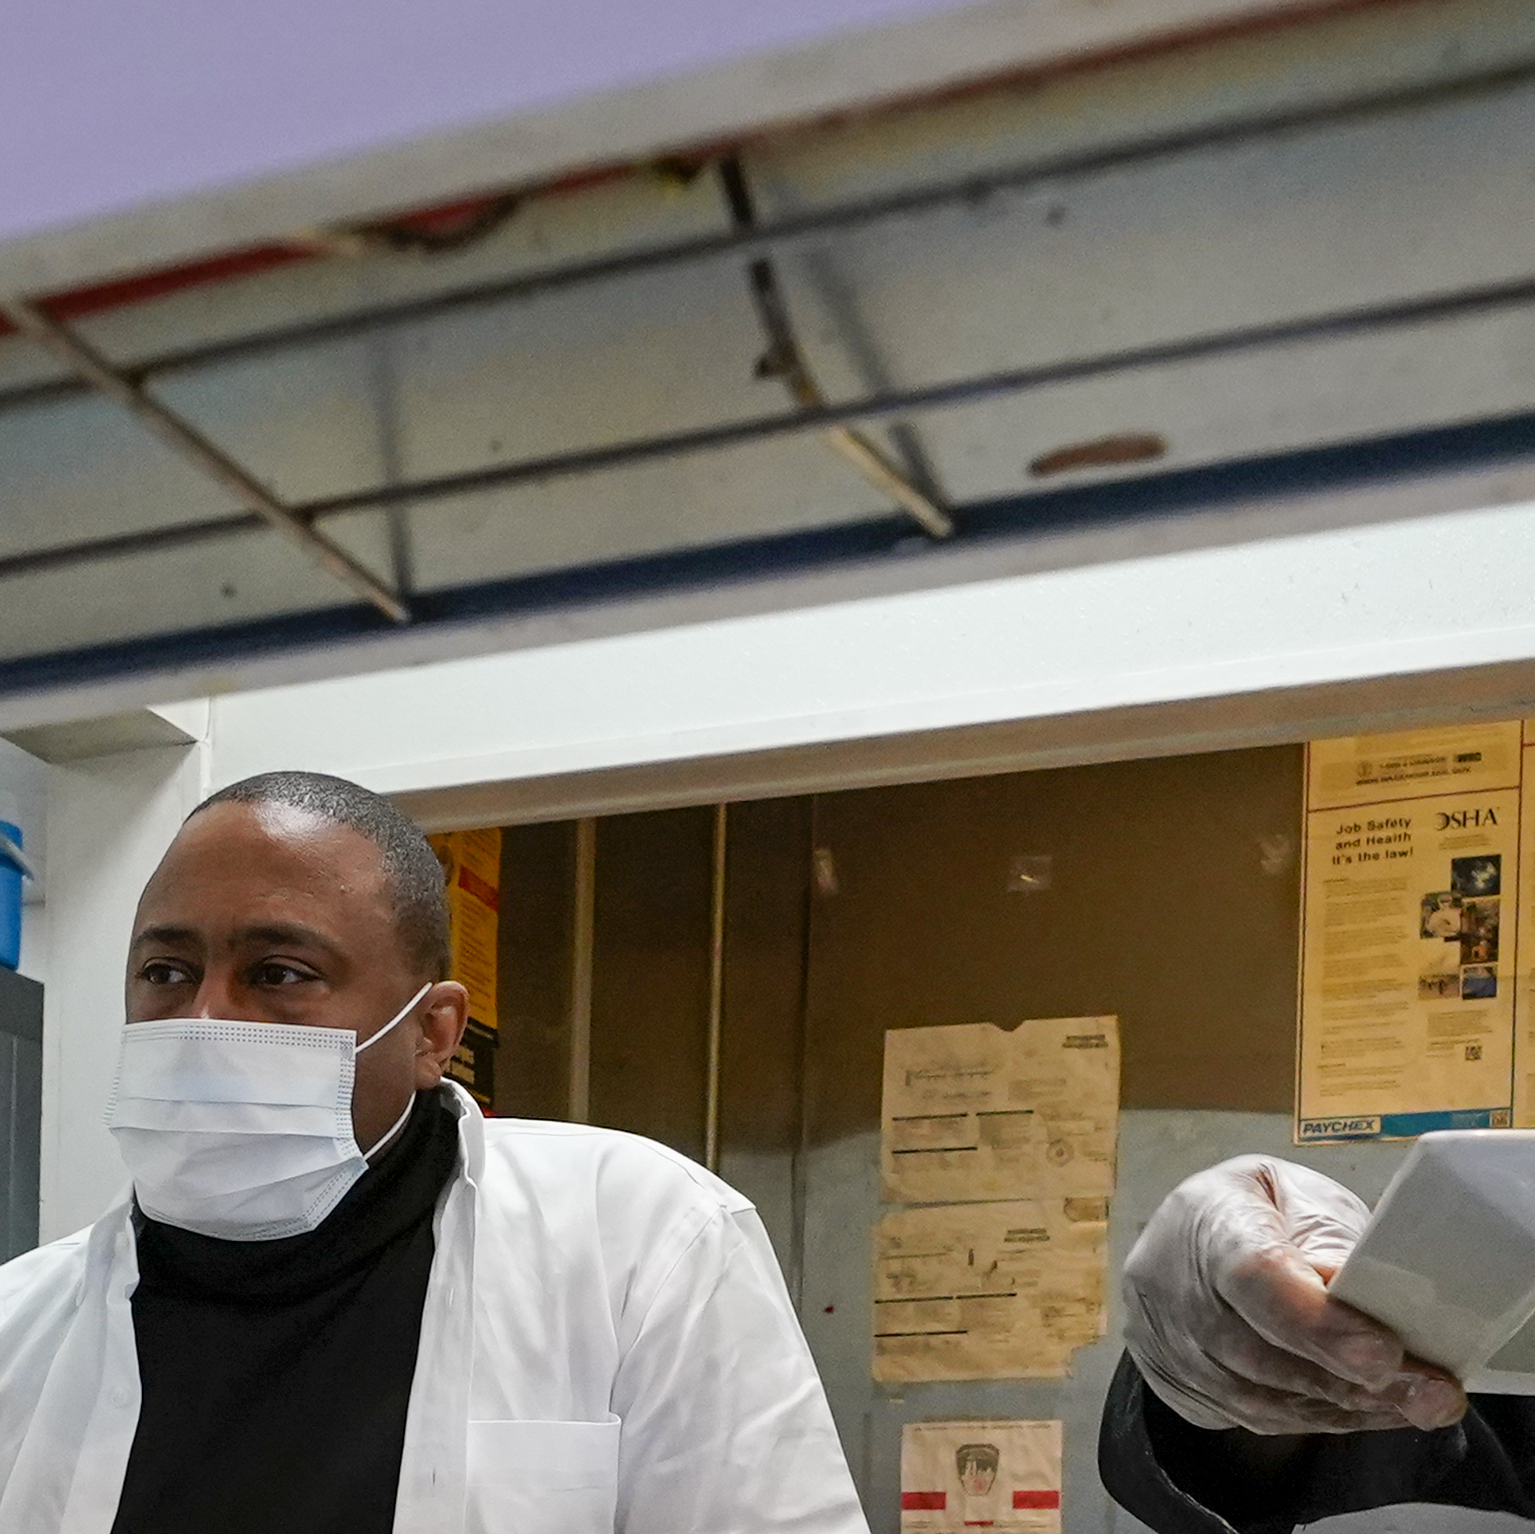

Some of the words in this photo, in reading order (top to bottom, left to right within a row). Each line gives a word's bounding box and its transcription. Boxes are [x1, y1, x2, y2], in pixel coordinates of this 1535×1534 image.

[1336, 822, 1361, 834] Job
[1367, 817, 1411, 831] Safety
[1435, 808, 1498, 831] OSHA
[1335, 838, 1361, 850] and
[1366, 832, 1411, 846] Health
[1358, 851, 1380, 861] the
[1385, 846, 1413, 858] law!
[1303, 1119, 1375, 1134] PAYCHEX
